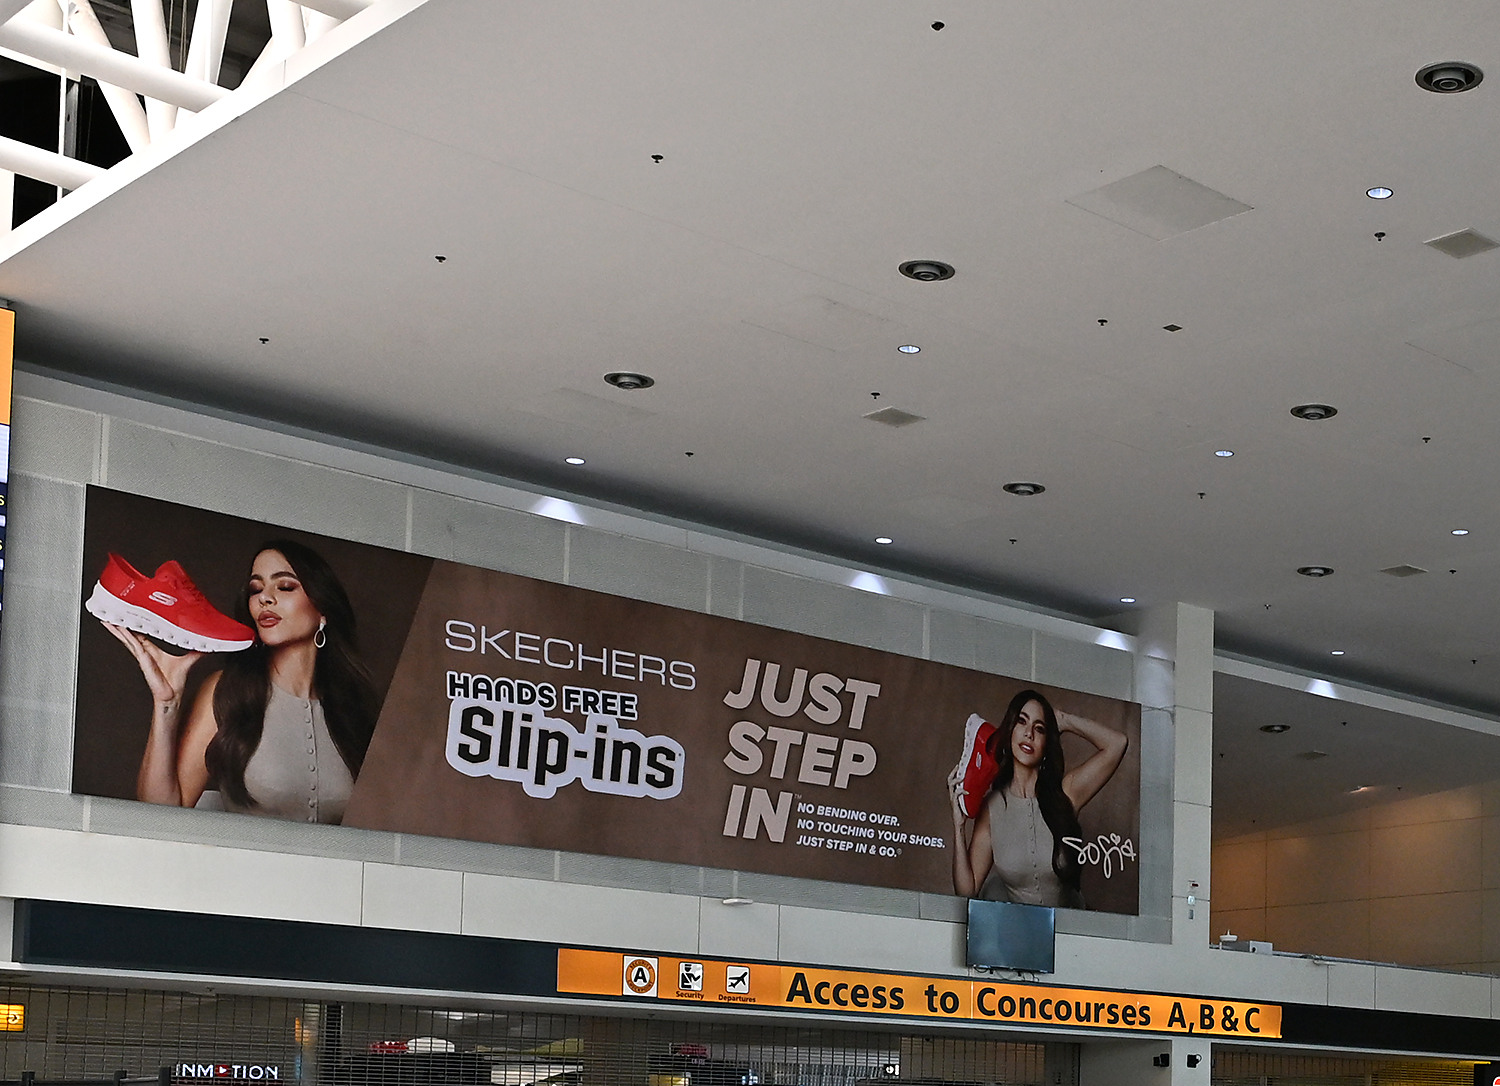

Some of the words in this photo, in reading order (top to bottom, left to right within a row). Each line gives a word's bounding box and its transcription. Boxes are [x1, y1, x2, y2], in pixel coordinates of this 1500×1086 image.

[445, 619, 697, 691] SKECHERS
[447, 671, 557, 710] HANDS
[562, 686, 638, 720] FREE
[723, 658, 881, 730] JUST
[458, 706, 677, 786] Slip-ins
[723, 720, 877, 789] STEP
[797, 802, 815, 814] NO
[817, 805, 866, 822] BENDING
[869, 813, 900, 827] OVER.
[797, 819, 815, 831] NO
[818, 821, 875, 839] TOUCHING
[877, 830, 906, 844] YOUR
[909, 834, 946, 848] SHOES.
[796, 835, 824, 848] JUST
[826, 839, 853, 852] STEP
[855, 843, 867, 854] IN
[869, 845, 876, 855] &
[634, 967, 647, 983] A
[676, 991, 704, 999] Security
[718, 994, 756, 1003] Departures
[786, 972, 904, 1010] Access
[925, 984, 960, 1014] to
[977, 987, 1151, 1026] Concourses
